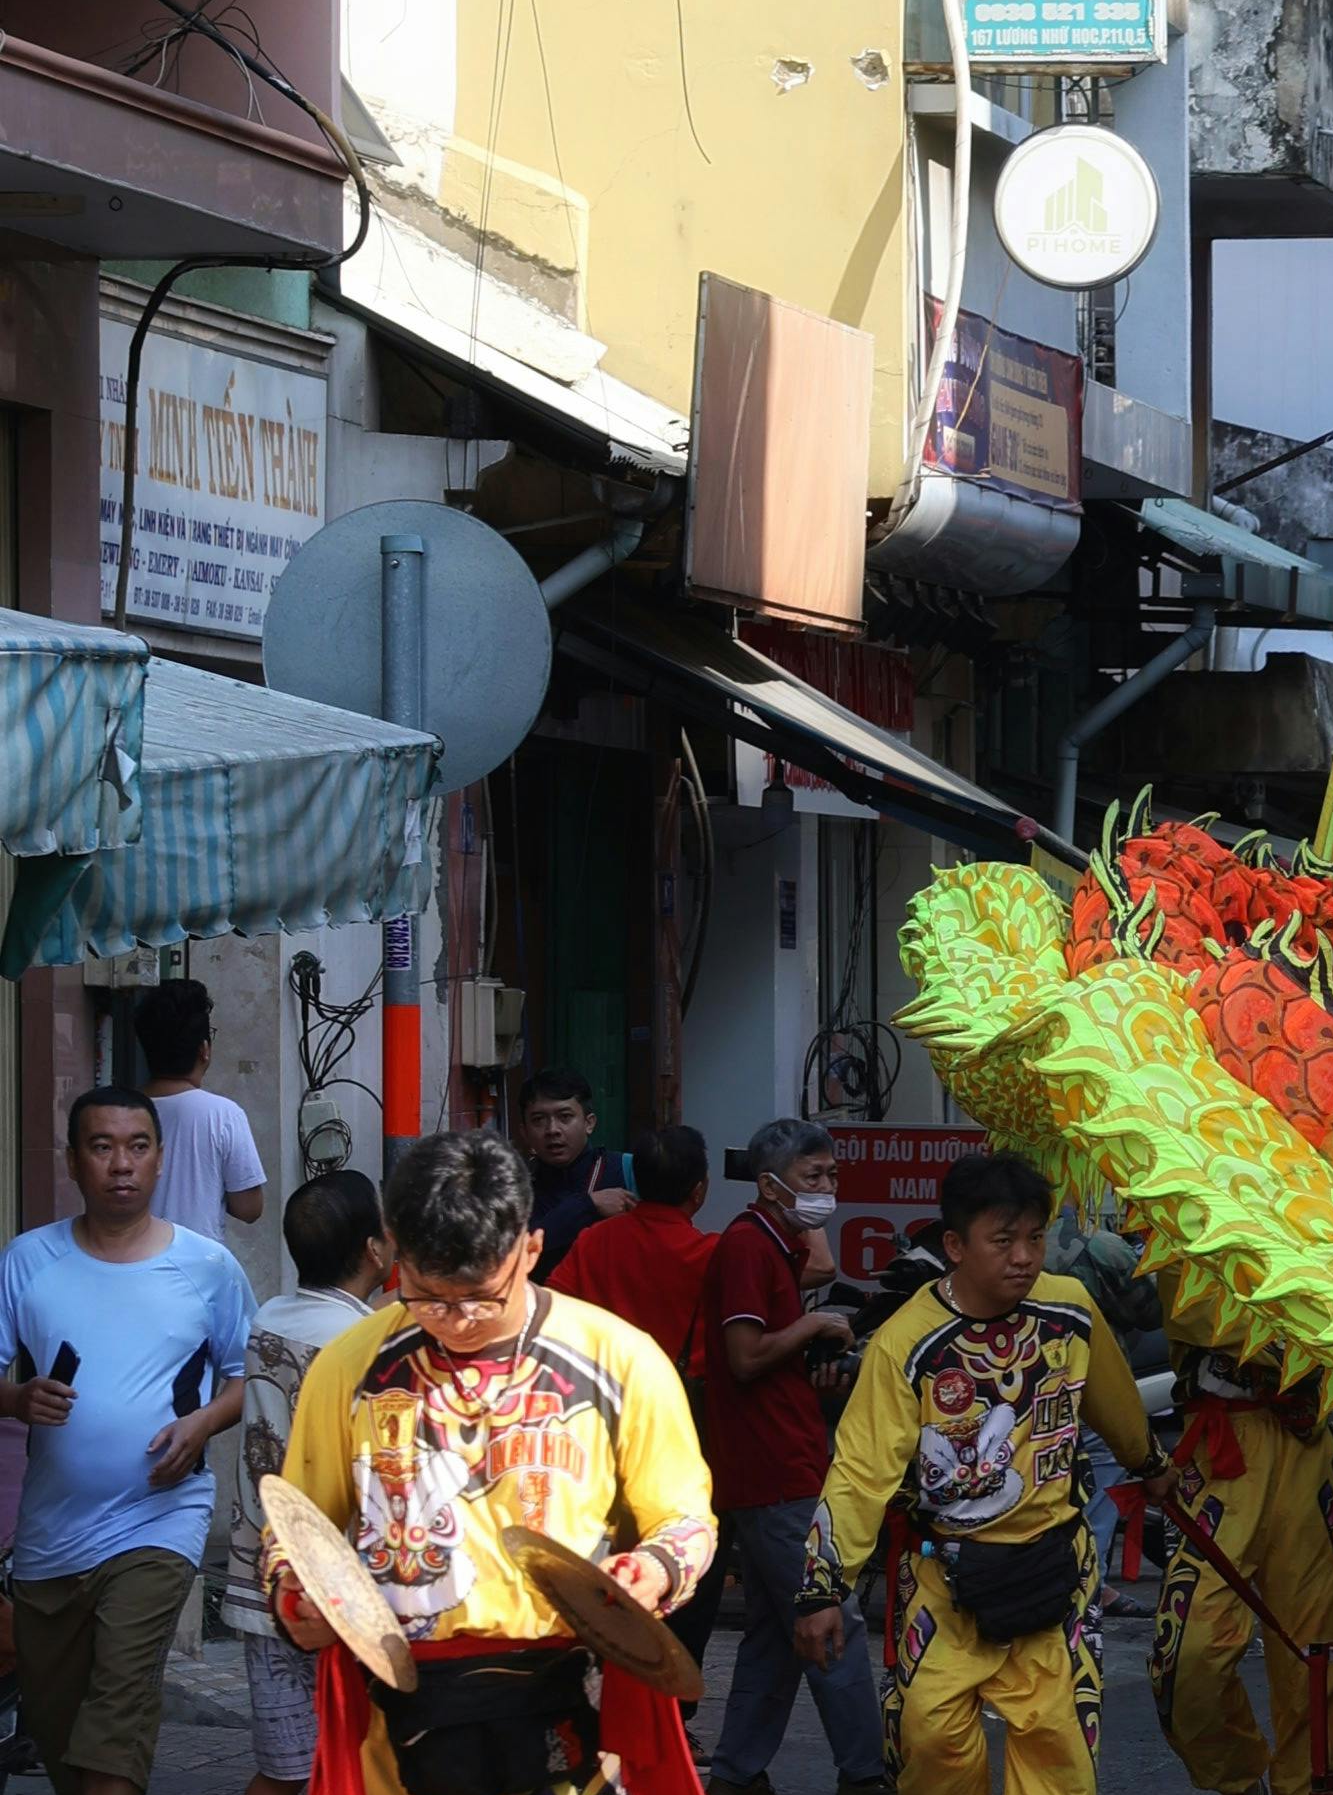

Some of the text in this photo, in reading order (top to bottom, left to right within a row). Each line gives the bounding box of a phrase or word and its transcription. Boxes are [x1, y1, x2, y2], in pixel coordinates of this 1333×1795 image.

[1054, 237, 1121, 254] HOME
[149, 387, 201, 491] MINH
[202, 370, 255, 502] TIẾN
[259, 397, 319, 518] THÀNH
[139, 508, 157, 534] LINH
[148, 551, 180, 579] EMERY
[233, 567, 265, 594] KANSAI
[833, 1134, 866, 1165] GỘI
[889, 1178, 937, 1200] NAM
